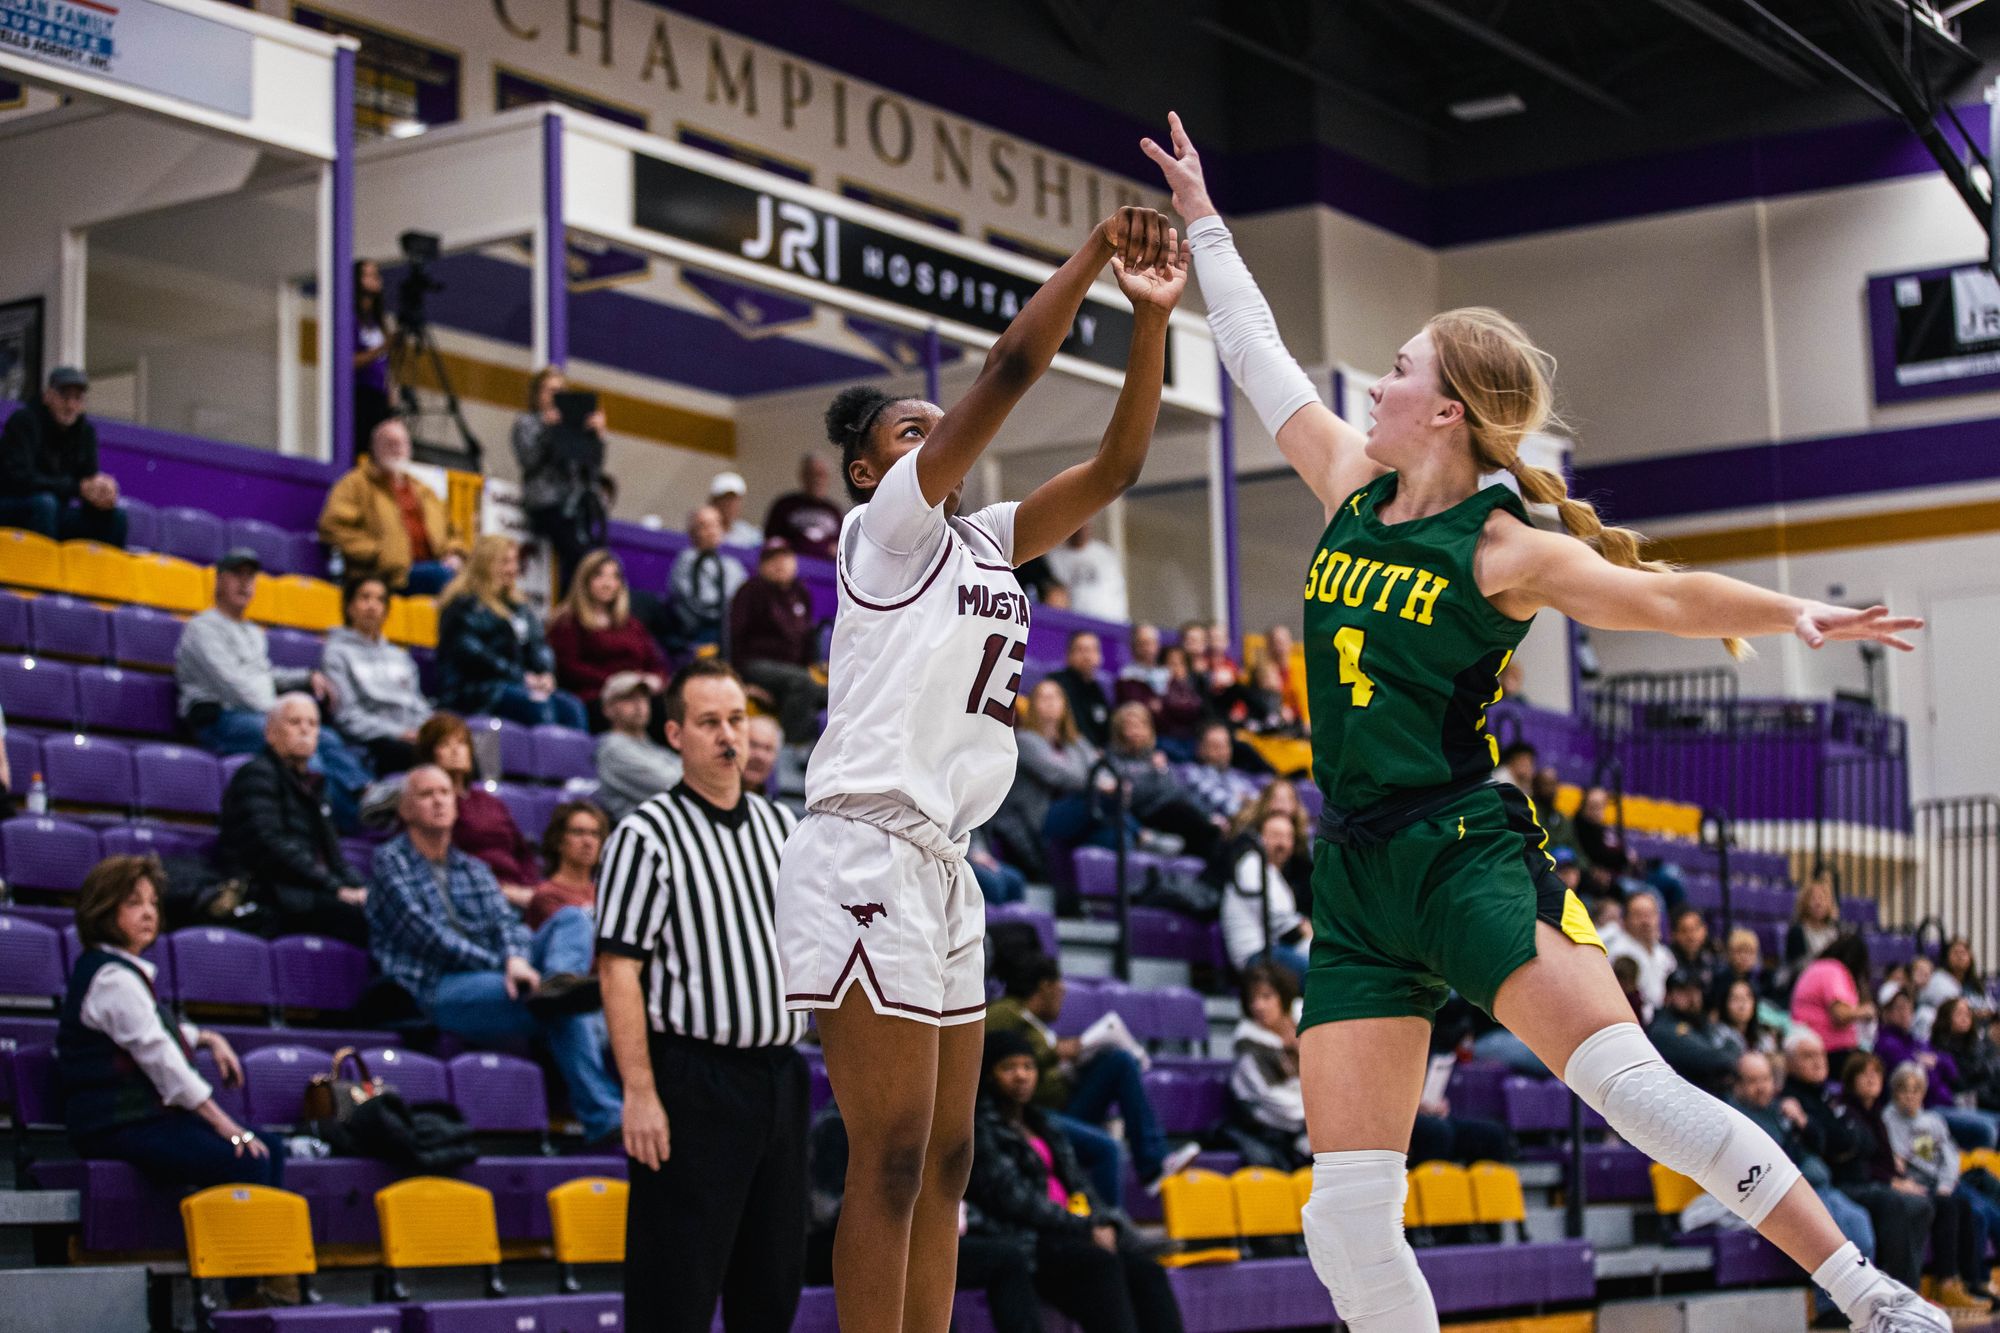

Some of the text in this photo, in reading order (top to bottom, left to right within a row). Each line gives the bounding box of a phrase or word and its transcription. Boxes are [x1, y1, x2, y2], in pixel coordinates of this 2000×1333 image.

[741, 194, 1097, 347] JRI HOSPITAY
[1304, 547, 1450, 626] SOUTH
[965, 632, 1027, 728] 13
[1332, 626, 1375, 708] 4
